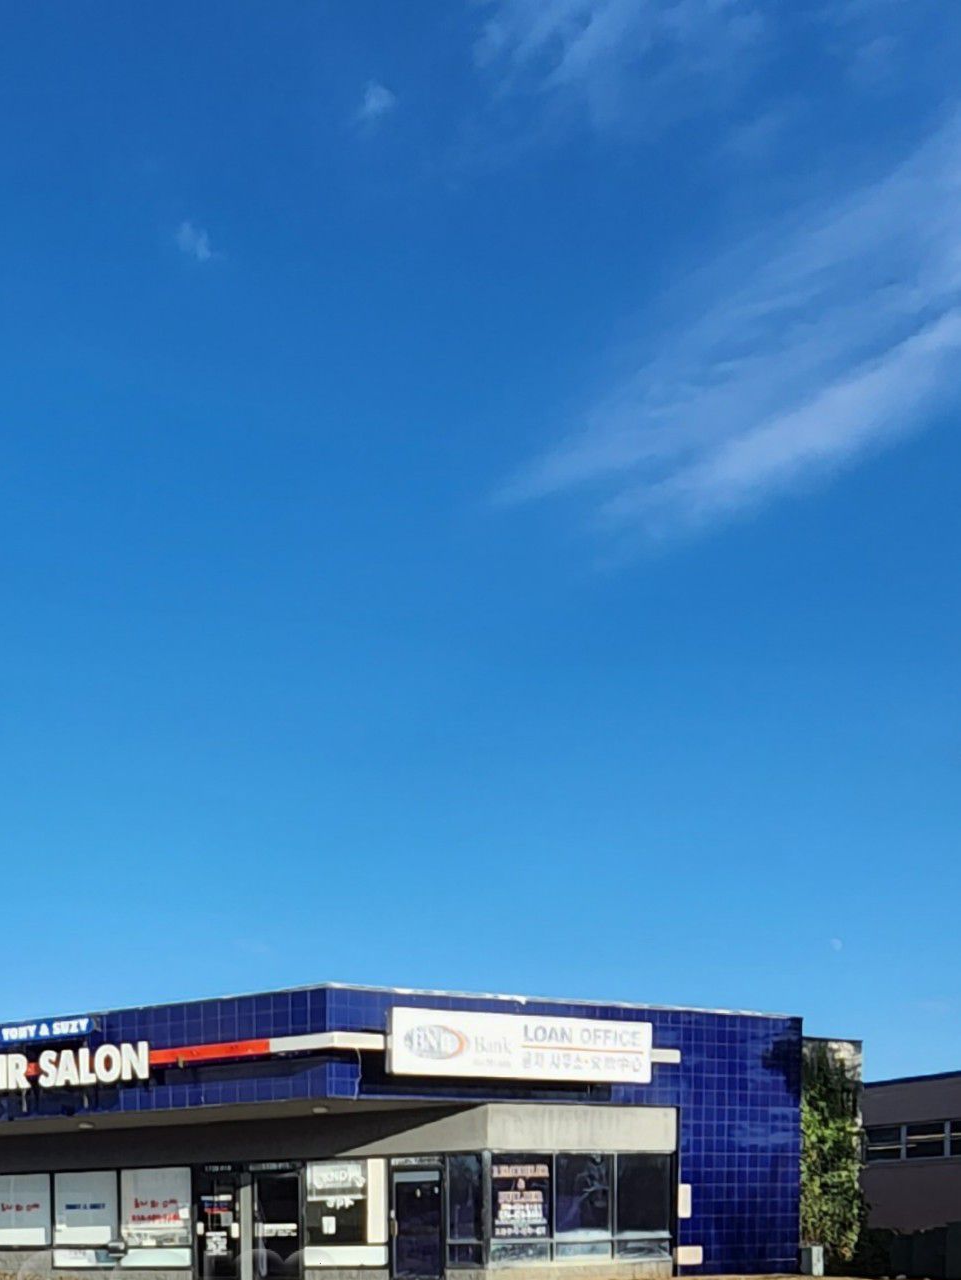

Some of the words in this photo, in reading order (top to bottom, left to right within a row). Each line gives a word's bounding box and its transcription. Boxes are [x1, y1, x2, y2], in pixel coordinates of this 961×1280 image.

[1, 1024, 37, 1041] TONY
[52, 1018, 89, 1035] SUZY
[523, 1024, 573, 1044] LOAN
[579, 1027, 642, 1047] OFFICE
[39, 1041, 149, 1088] SALON
